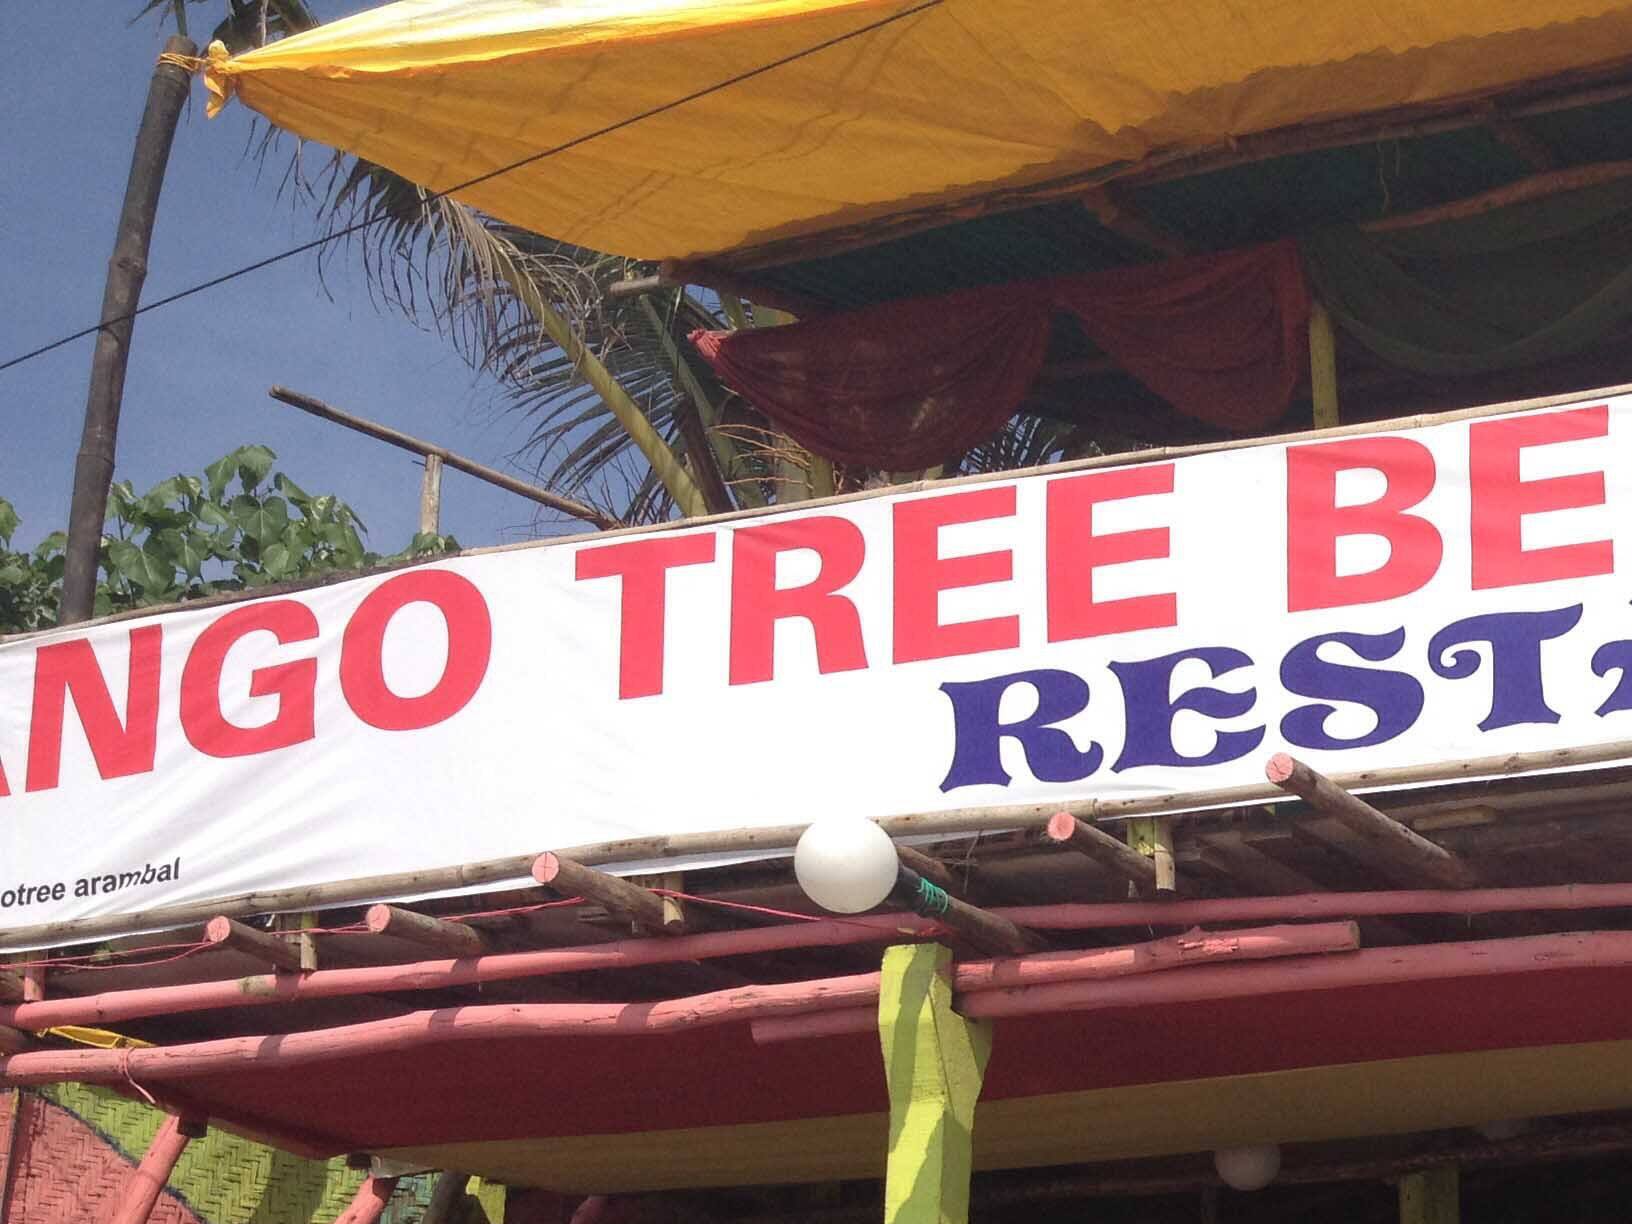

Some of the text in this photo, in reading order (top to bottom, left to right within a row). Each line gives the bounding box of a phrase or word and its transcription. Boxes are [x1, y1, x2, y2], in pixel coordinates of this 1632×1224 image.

[0, 568, 493, 797] NGO
[574, 462, 1179, 701] TREE
[74, 856, 181, 897] arambal
